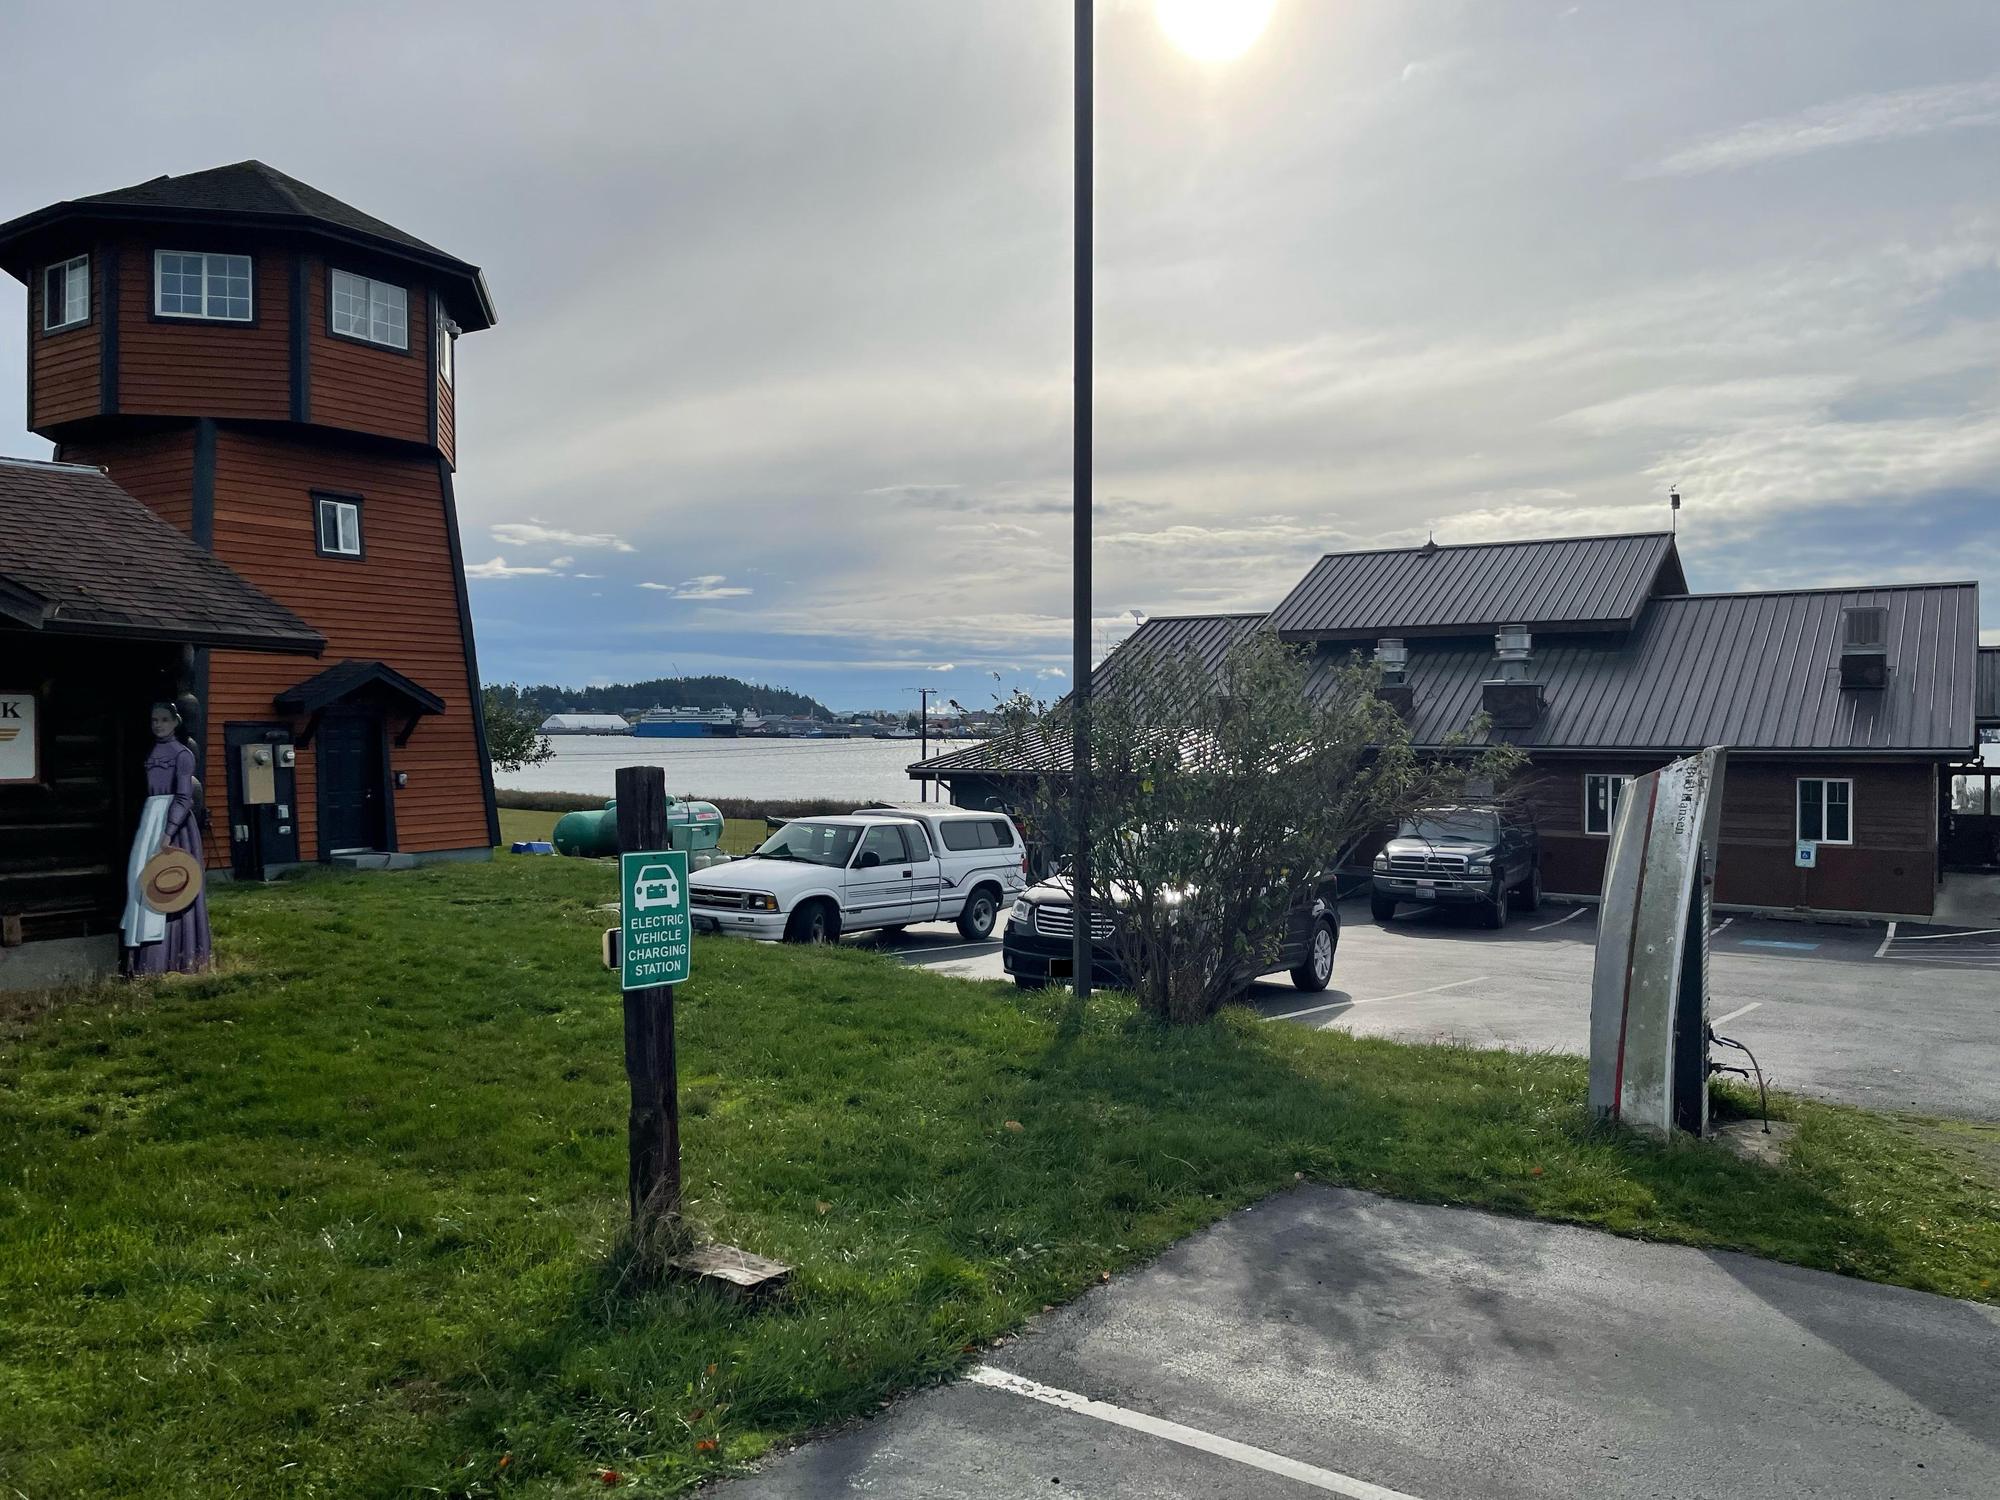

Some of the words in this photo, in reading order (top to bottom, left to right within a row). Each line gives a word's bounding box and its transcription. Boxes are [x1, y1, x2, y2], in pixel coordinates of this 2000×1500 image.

[1675, 793, 1692, 834] Hansen
[631, 914, 684, 929] ELECTRIC
[635, 929, 681, 944] VEHICLE
[628, 944, 686, 961] CHARGING
[635, 960, 681, 976] STATION
